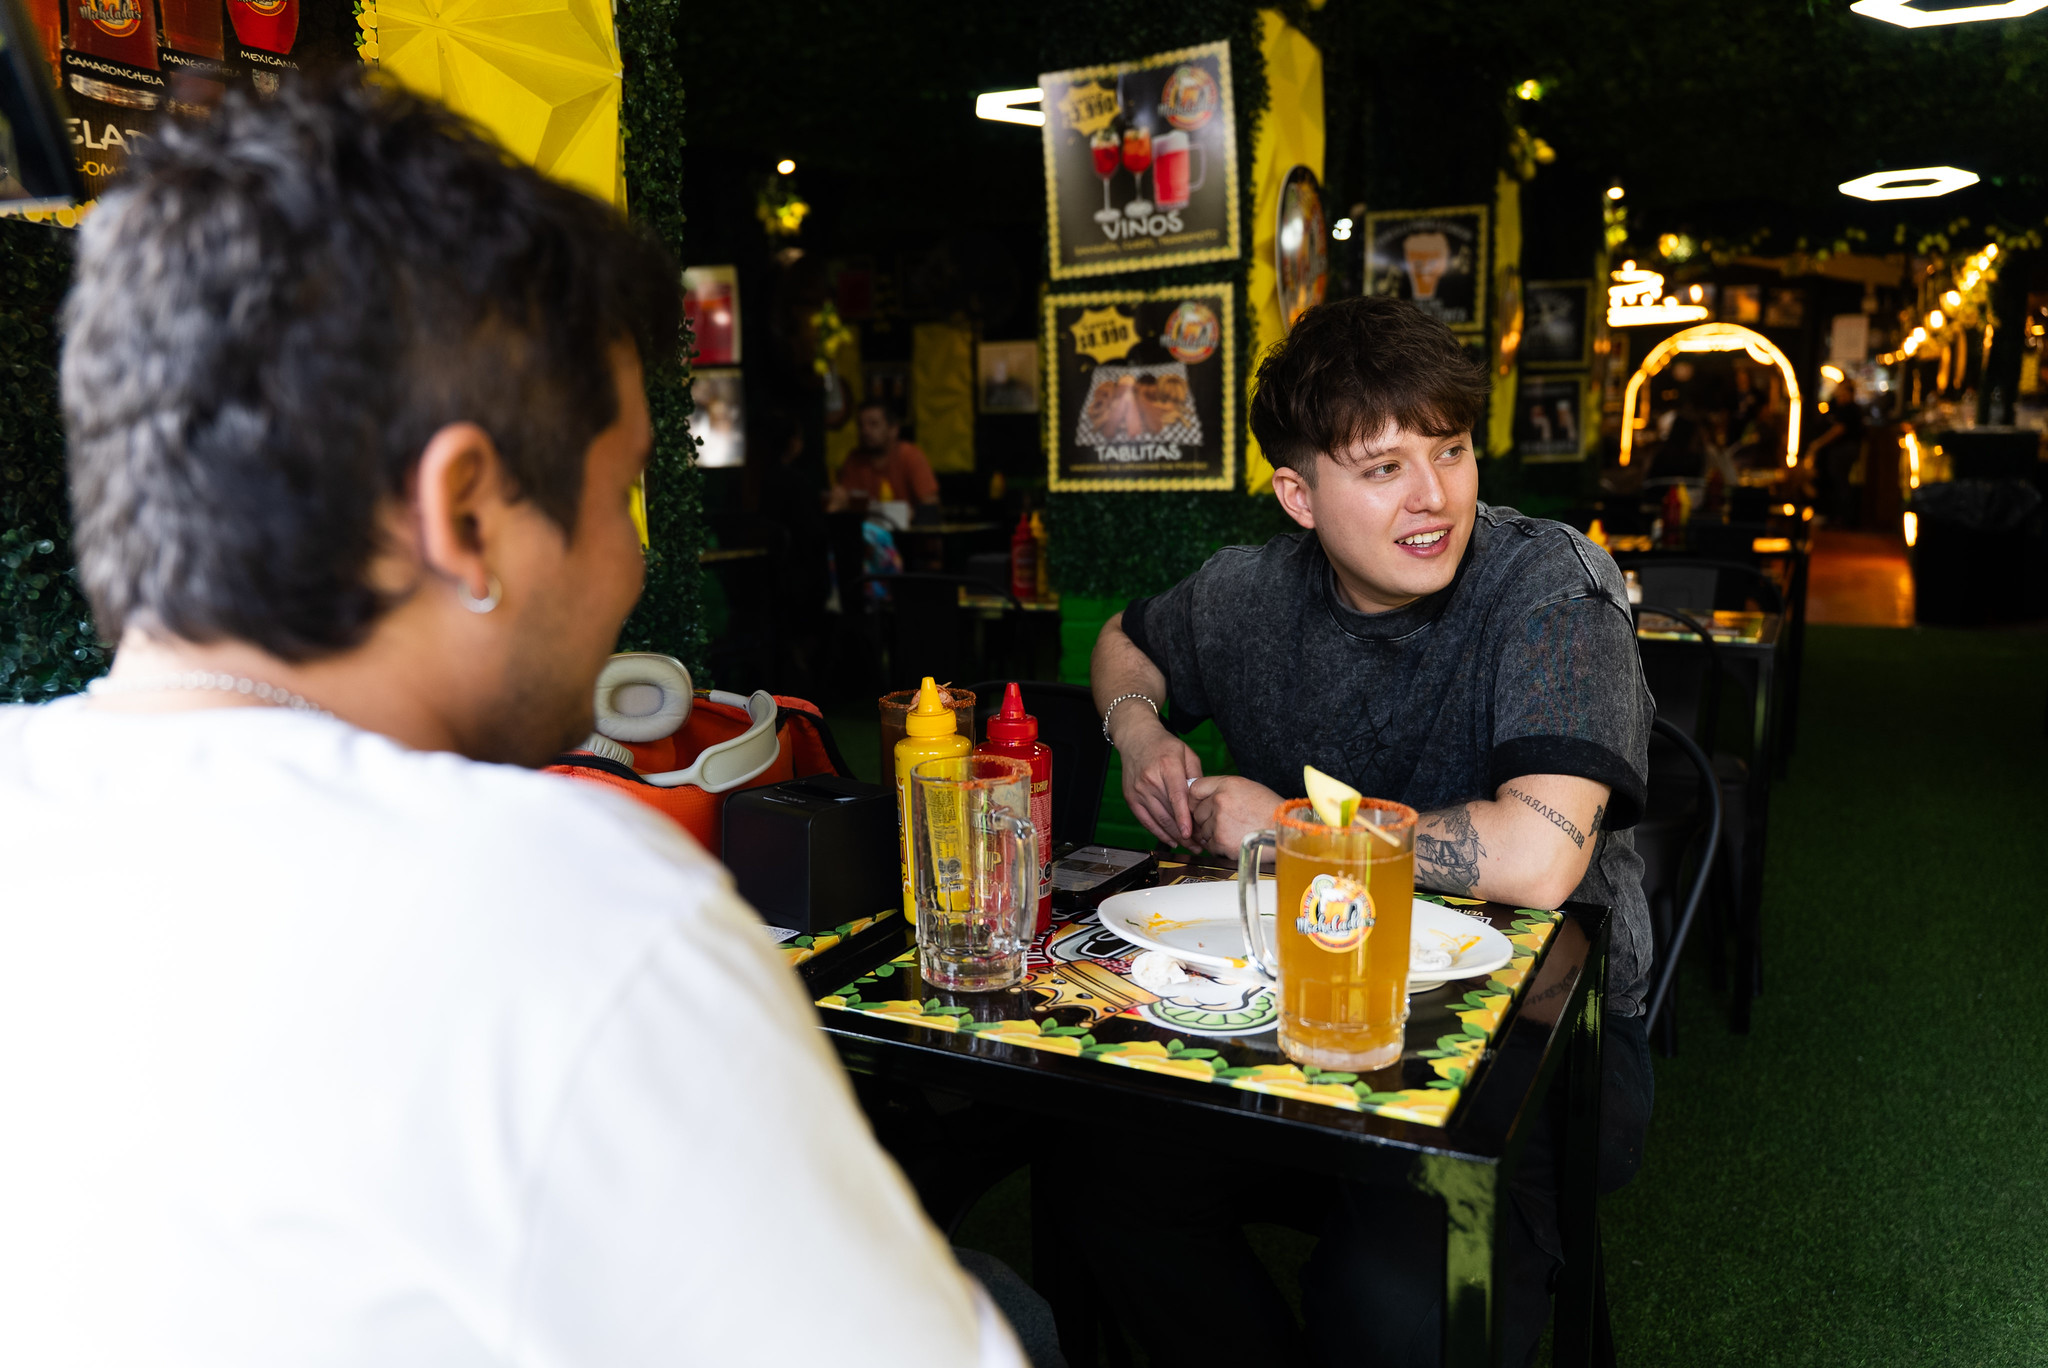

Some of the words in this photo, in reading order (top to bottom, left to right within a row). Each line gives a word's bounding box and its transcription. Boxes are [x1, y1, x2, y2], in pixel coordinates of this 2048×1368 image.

[65, 54, 165, 87] CAMARONCHELA
[240, 50, 300, 71] MEXICANA
[1102, 210, 1184, 240] VINOS
[1095, 442, 1182, 461] TABLITAS
